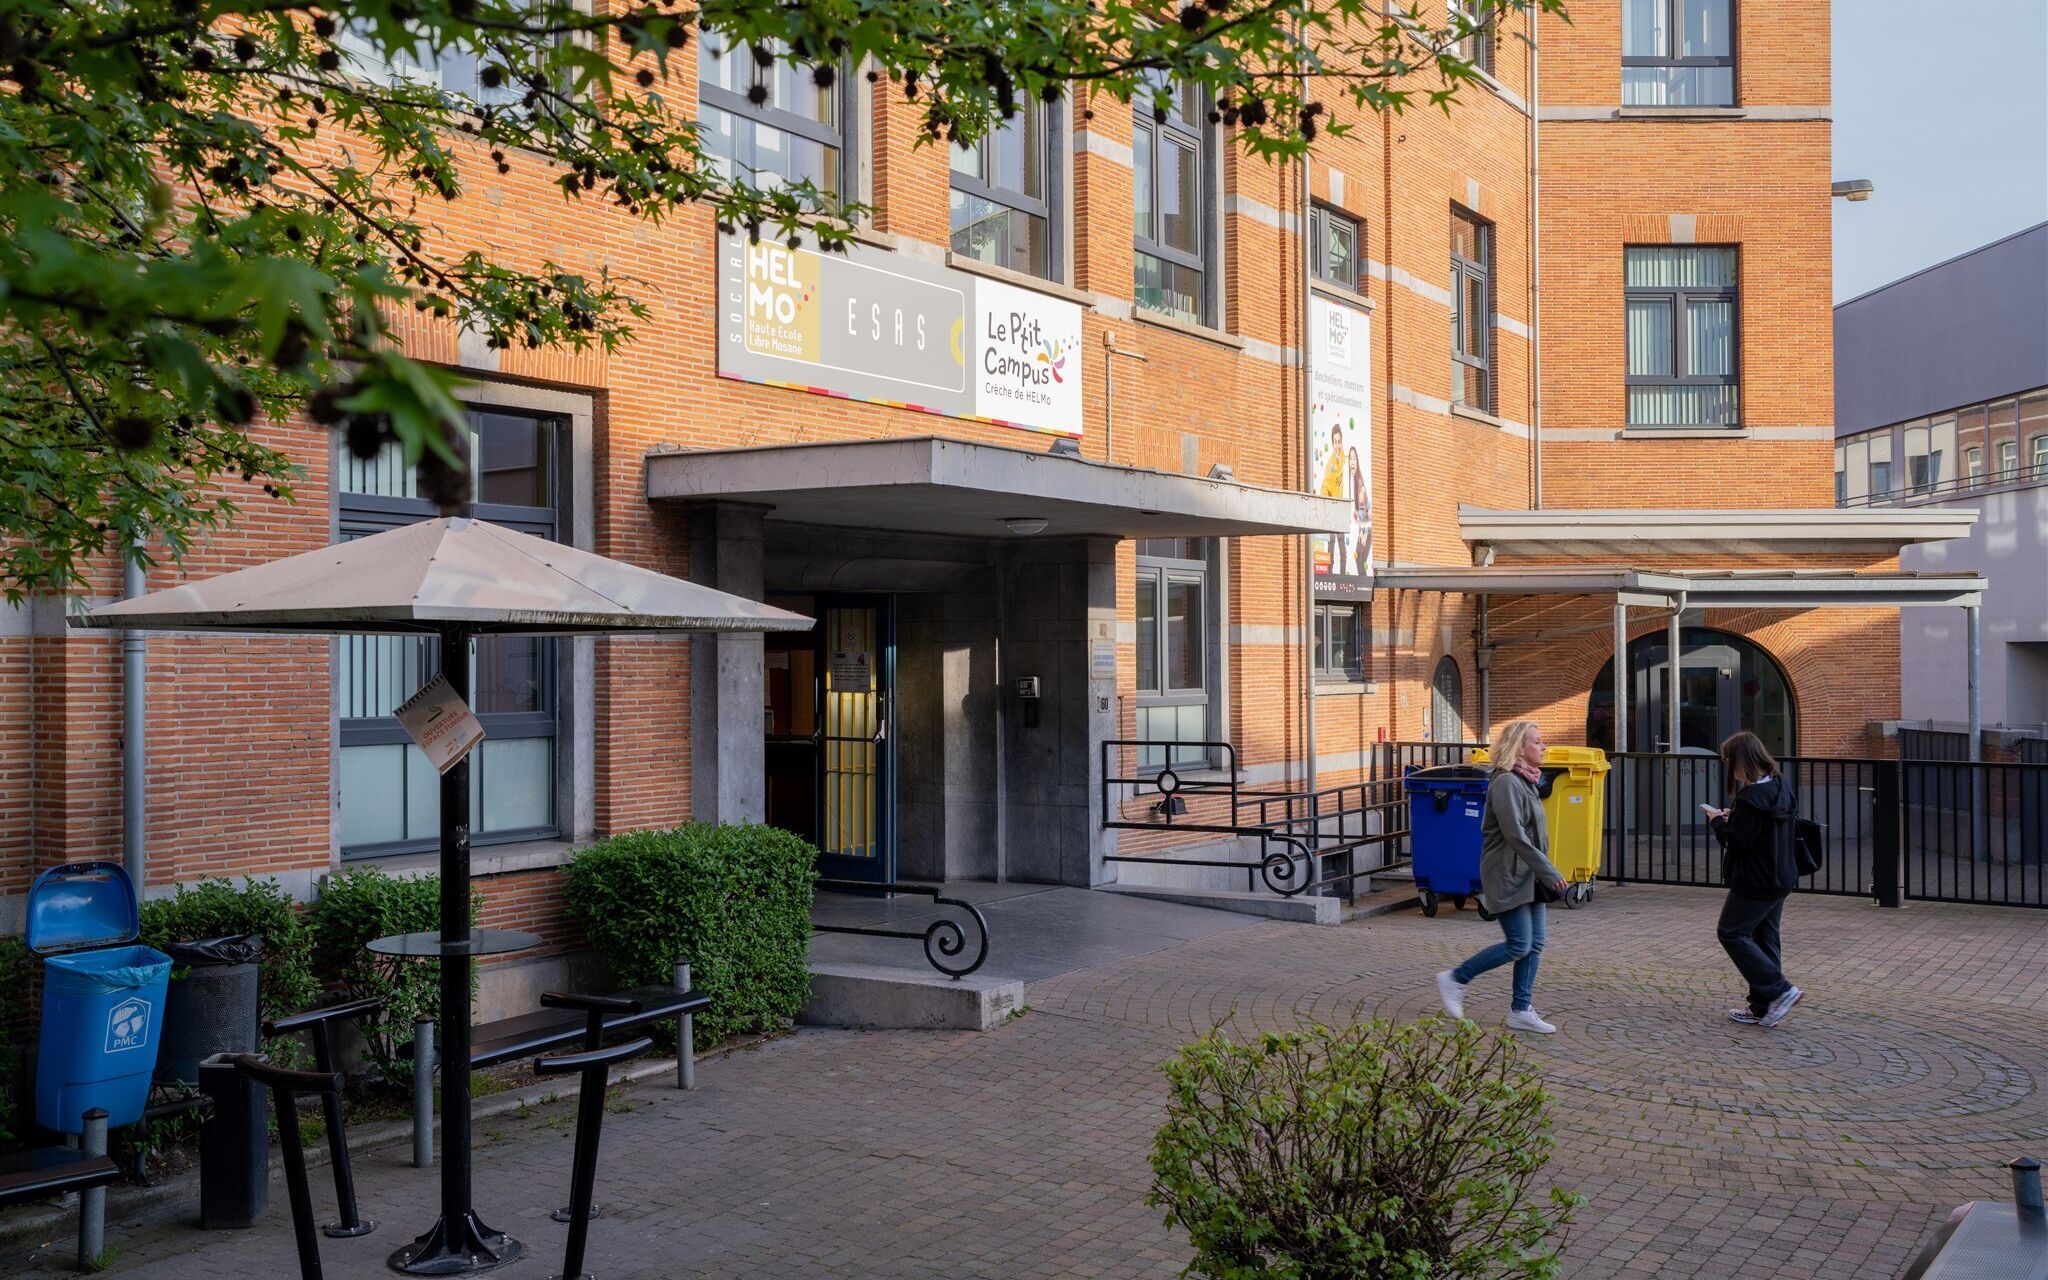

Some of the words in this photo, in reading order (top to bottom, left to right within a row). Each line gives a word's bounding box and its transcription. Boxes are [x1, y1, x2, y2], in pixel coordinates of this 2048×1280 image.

[749, 245, 802, 289] HEL
[730, 240, 742, 343] SOCIAL
[749, 319, 776, 336] Haute
[848, 297, 925, 350] ESAS
[988, 311, 1006, 342] Le
[1010, 312, 1041, 354] P'tit
[1329, 310, 1344, 329] HEL
[749, 333, 771, 349] Libre
[772, 340, 802, 355] Mosane
[984, 346, 1050, 387] Campus
[985, 382, 1012, 398] Crèche
[1014, 388, 1024, 400] de
[423, 710, 459, 739] OUVERTURE
[113, 1036, 137, 1049] PMC
